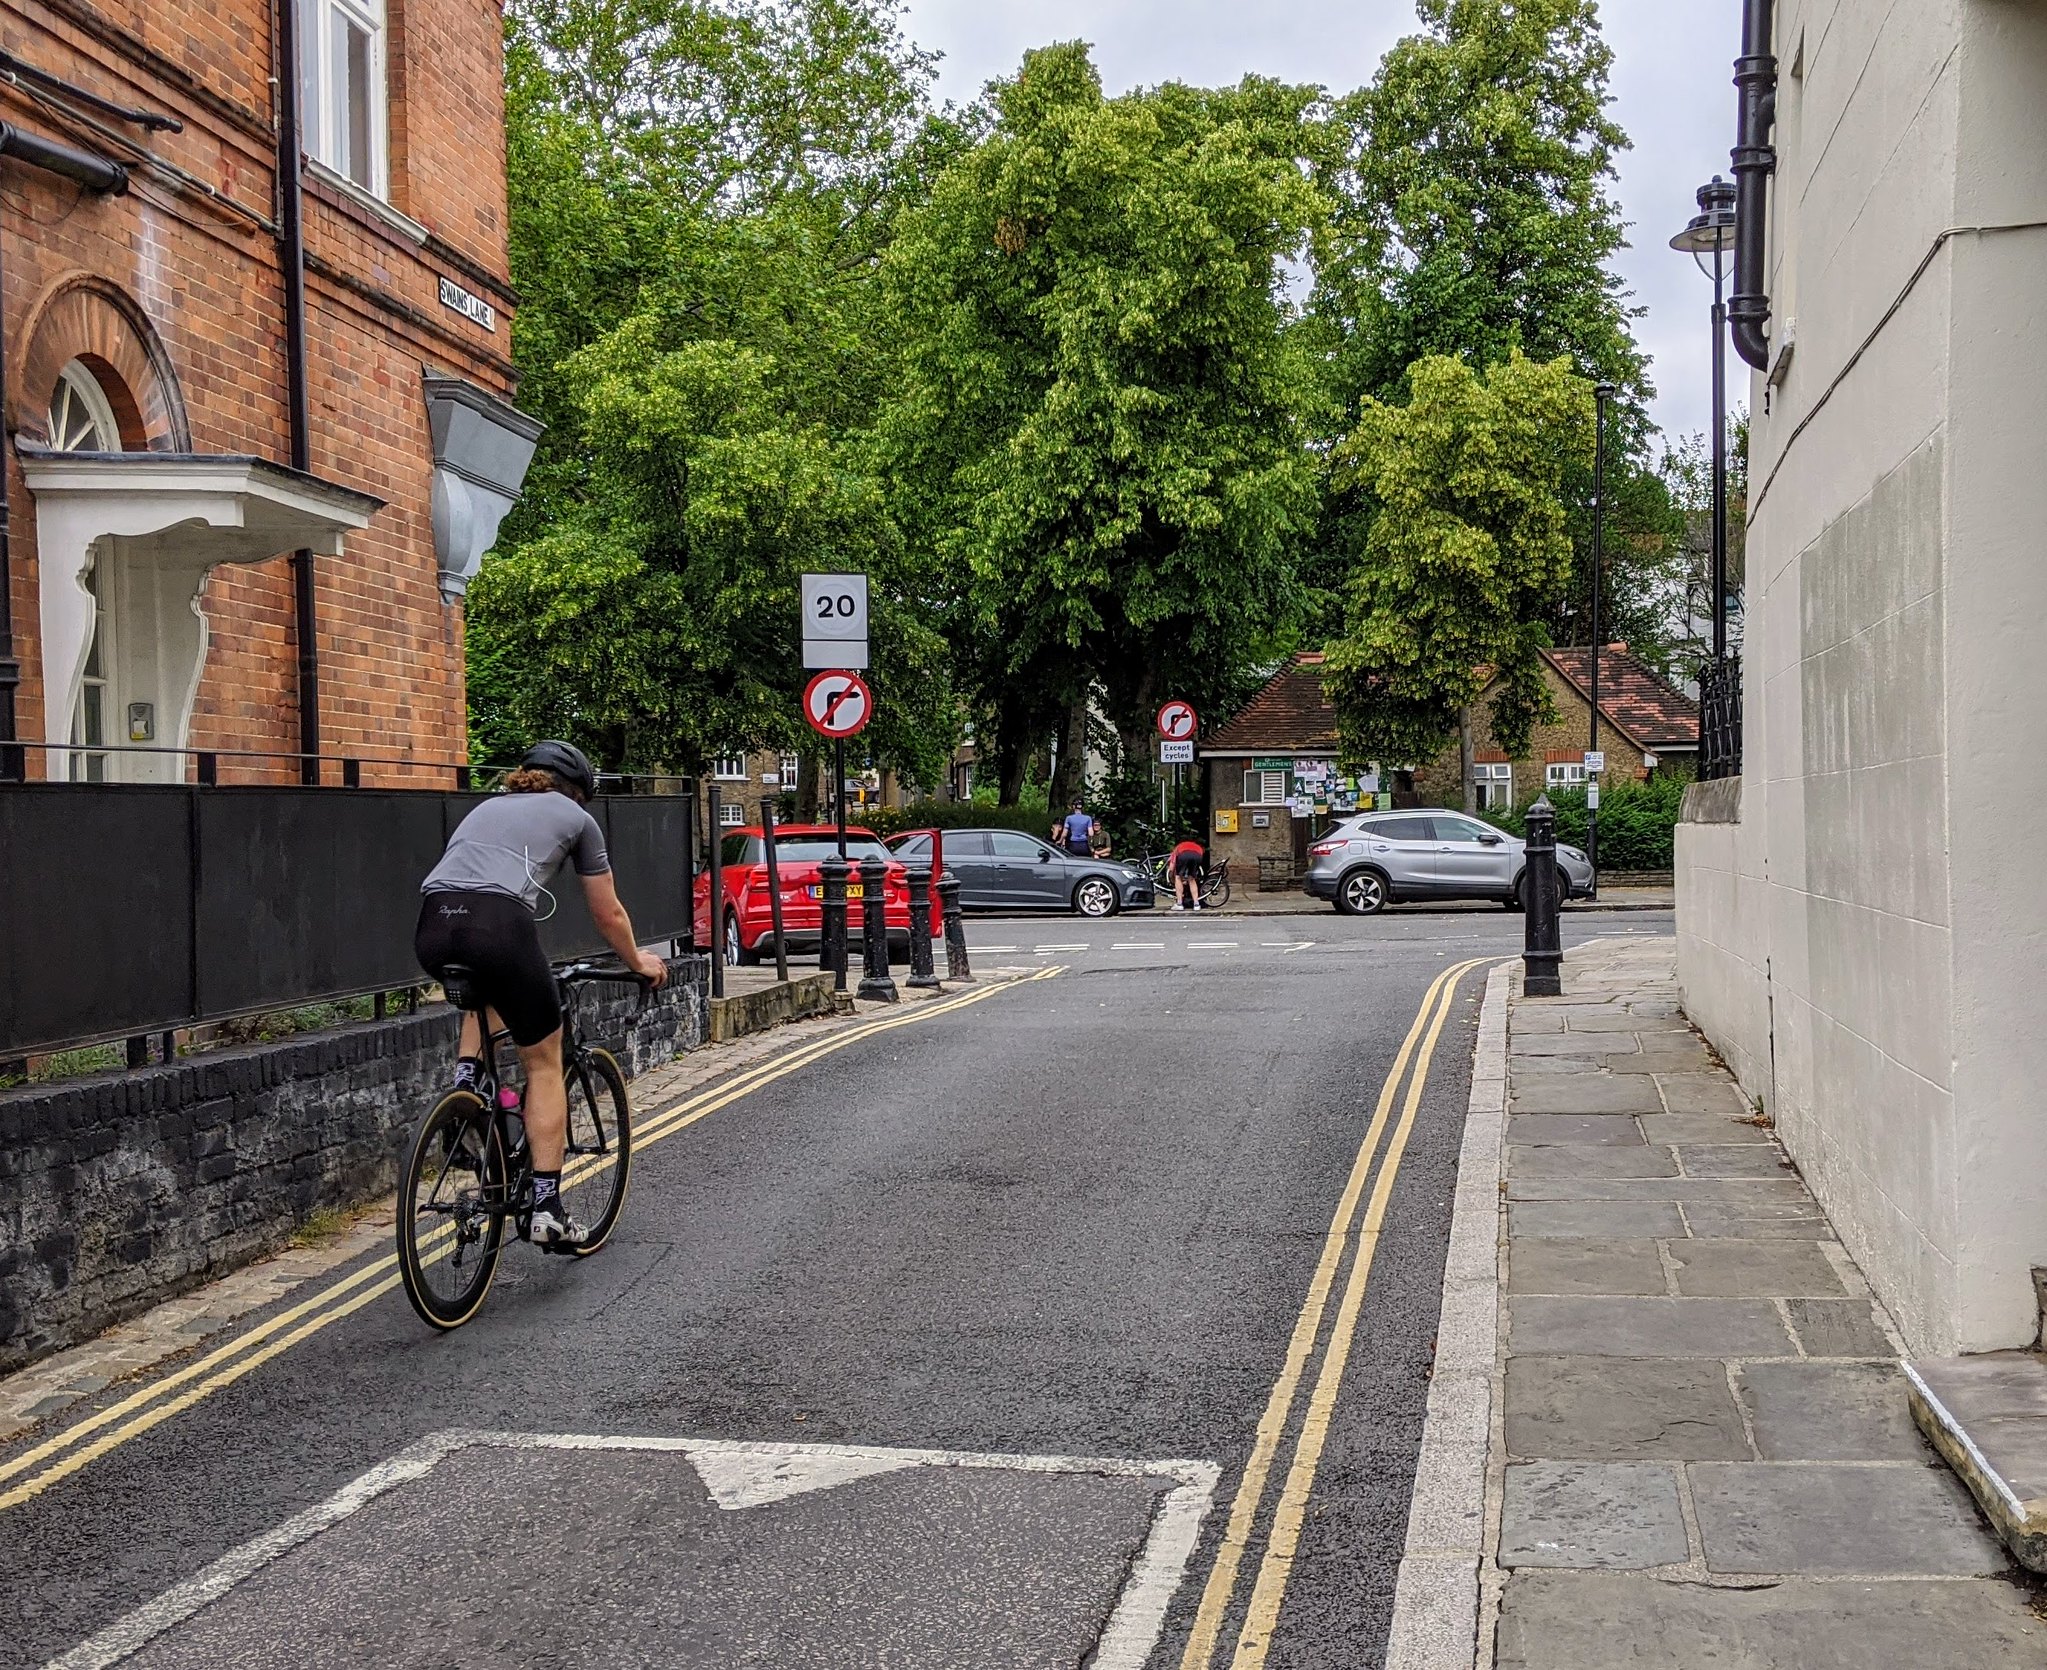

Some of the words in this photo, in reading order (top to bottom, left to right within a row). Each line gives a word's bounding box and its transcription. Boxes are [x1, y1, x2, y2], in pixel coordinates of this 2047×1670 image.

[440, 280, 468, 312] SWAINS
[470, 298, 489, 325] LANE
[816, 595, 855, 617] 20
[1165, 752, 1189, 760] cycles
[438, 905, 468, 918] Rapha
